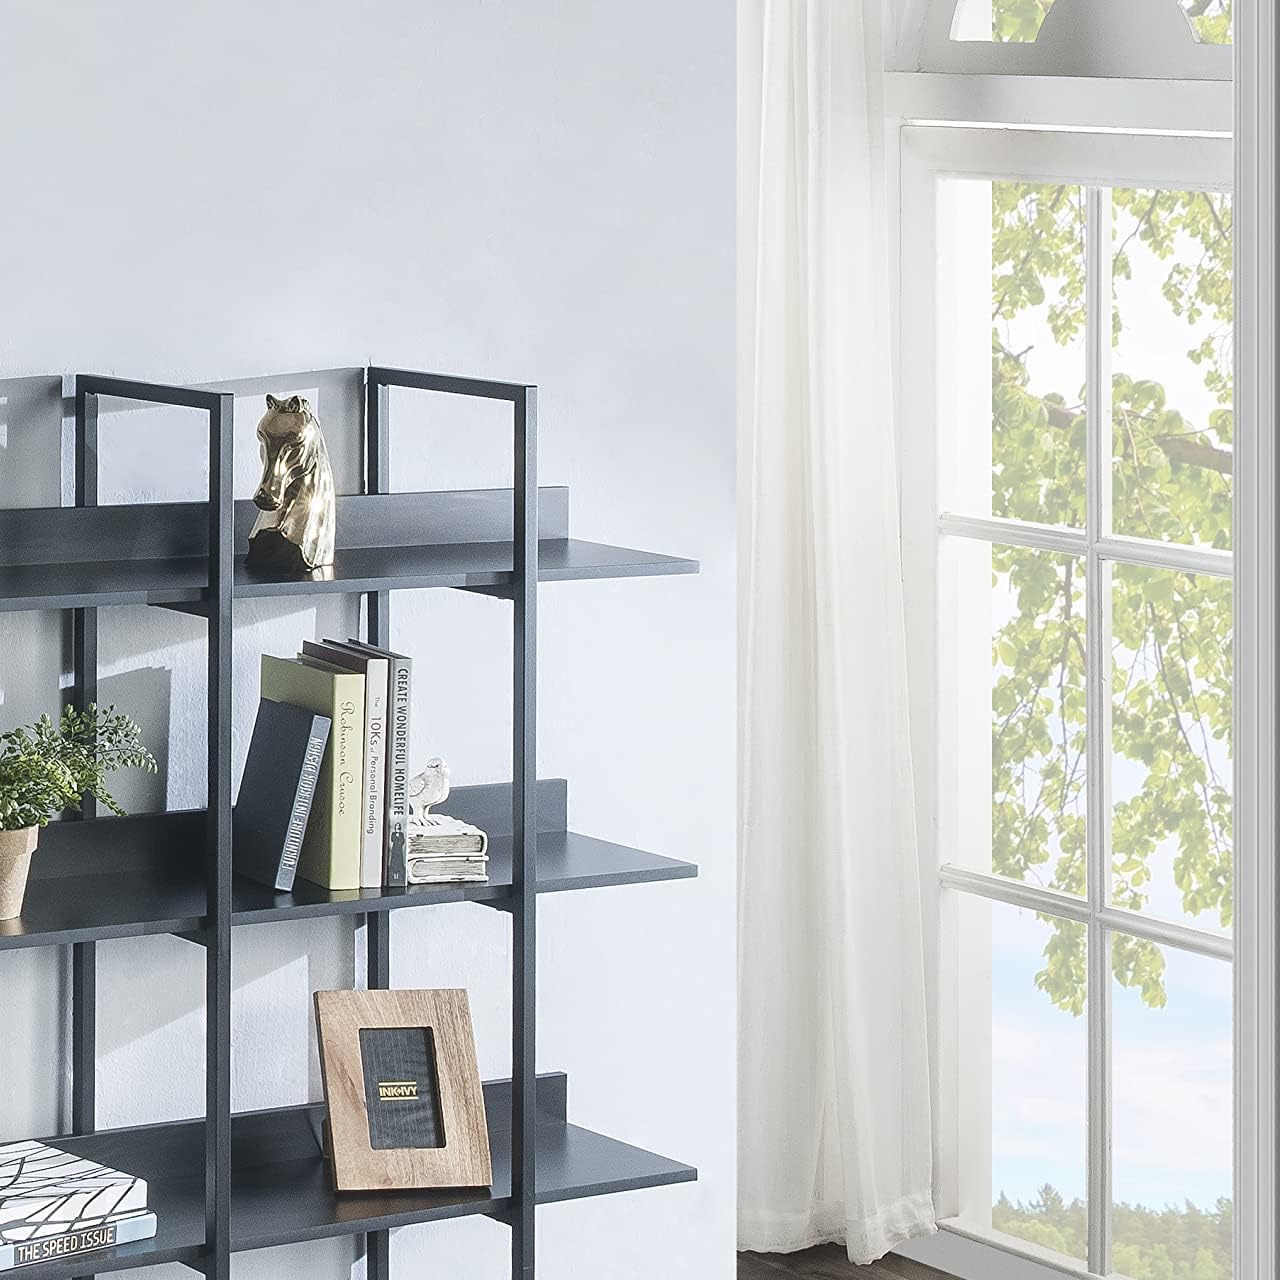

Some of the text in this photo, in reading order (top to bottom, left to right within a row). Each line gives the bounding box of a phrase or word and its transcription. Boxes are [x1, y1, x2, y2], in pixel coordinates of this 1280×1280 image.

[370, 716, 382, 746] 10Ks
[393, 668, 408, 816] CREATE WONDERFUL HOMELIFE
[338, 701, 356, 816] Robinson Crusoe
[369, 756, 379, 796] Personal
[366, 795, 378, 835] Branding
[18, 1227, 114, 1262] THE SPEED ISSUE
